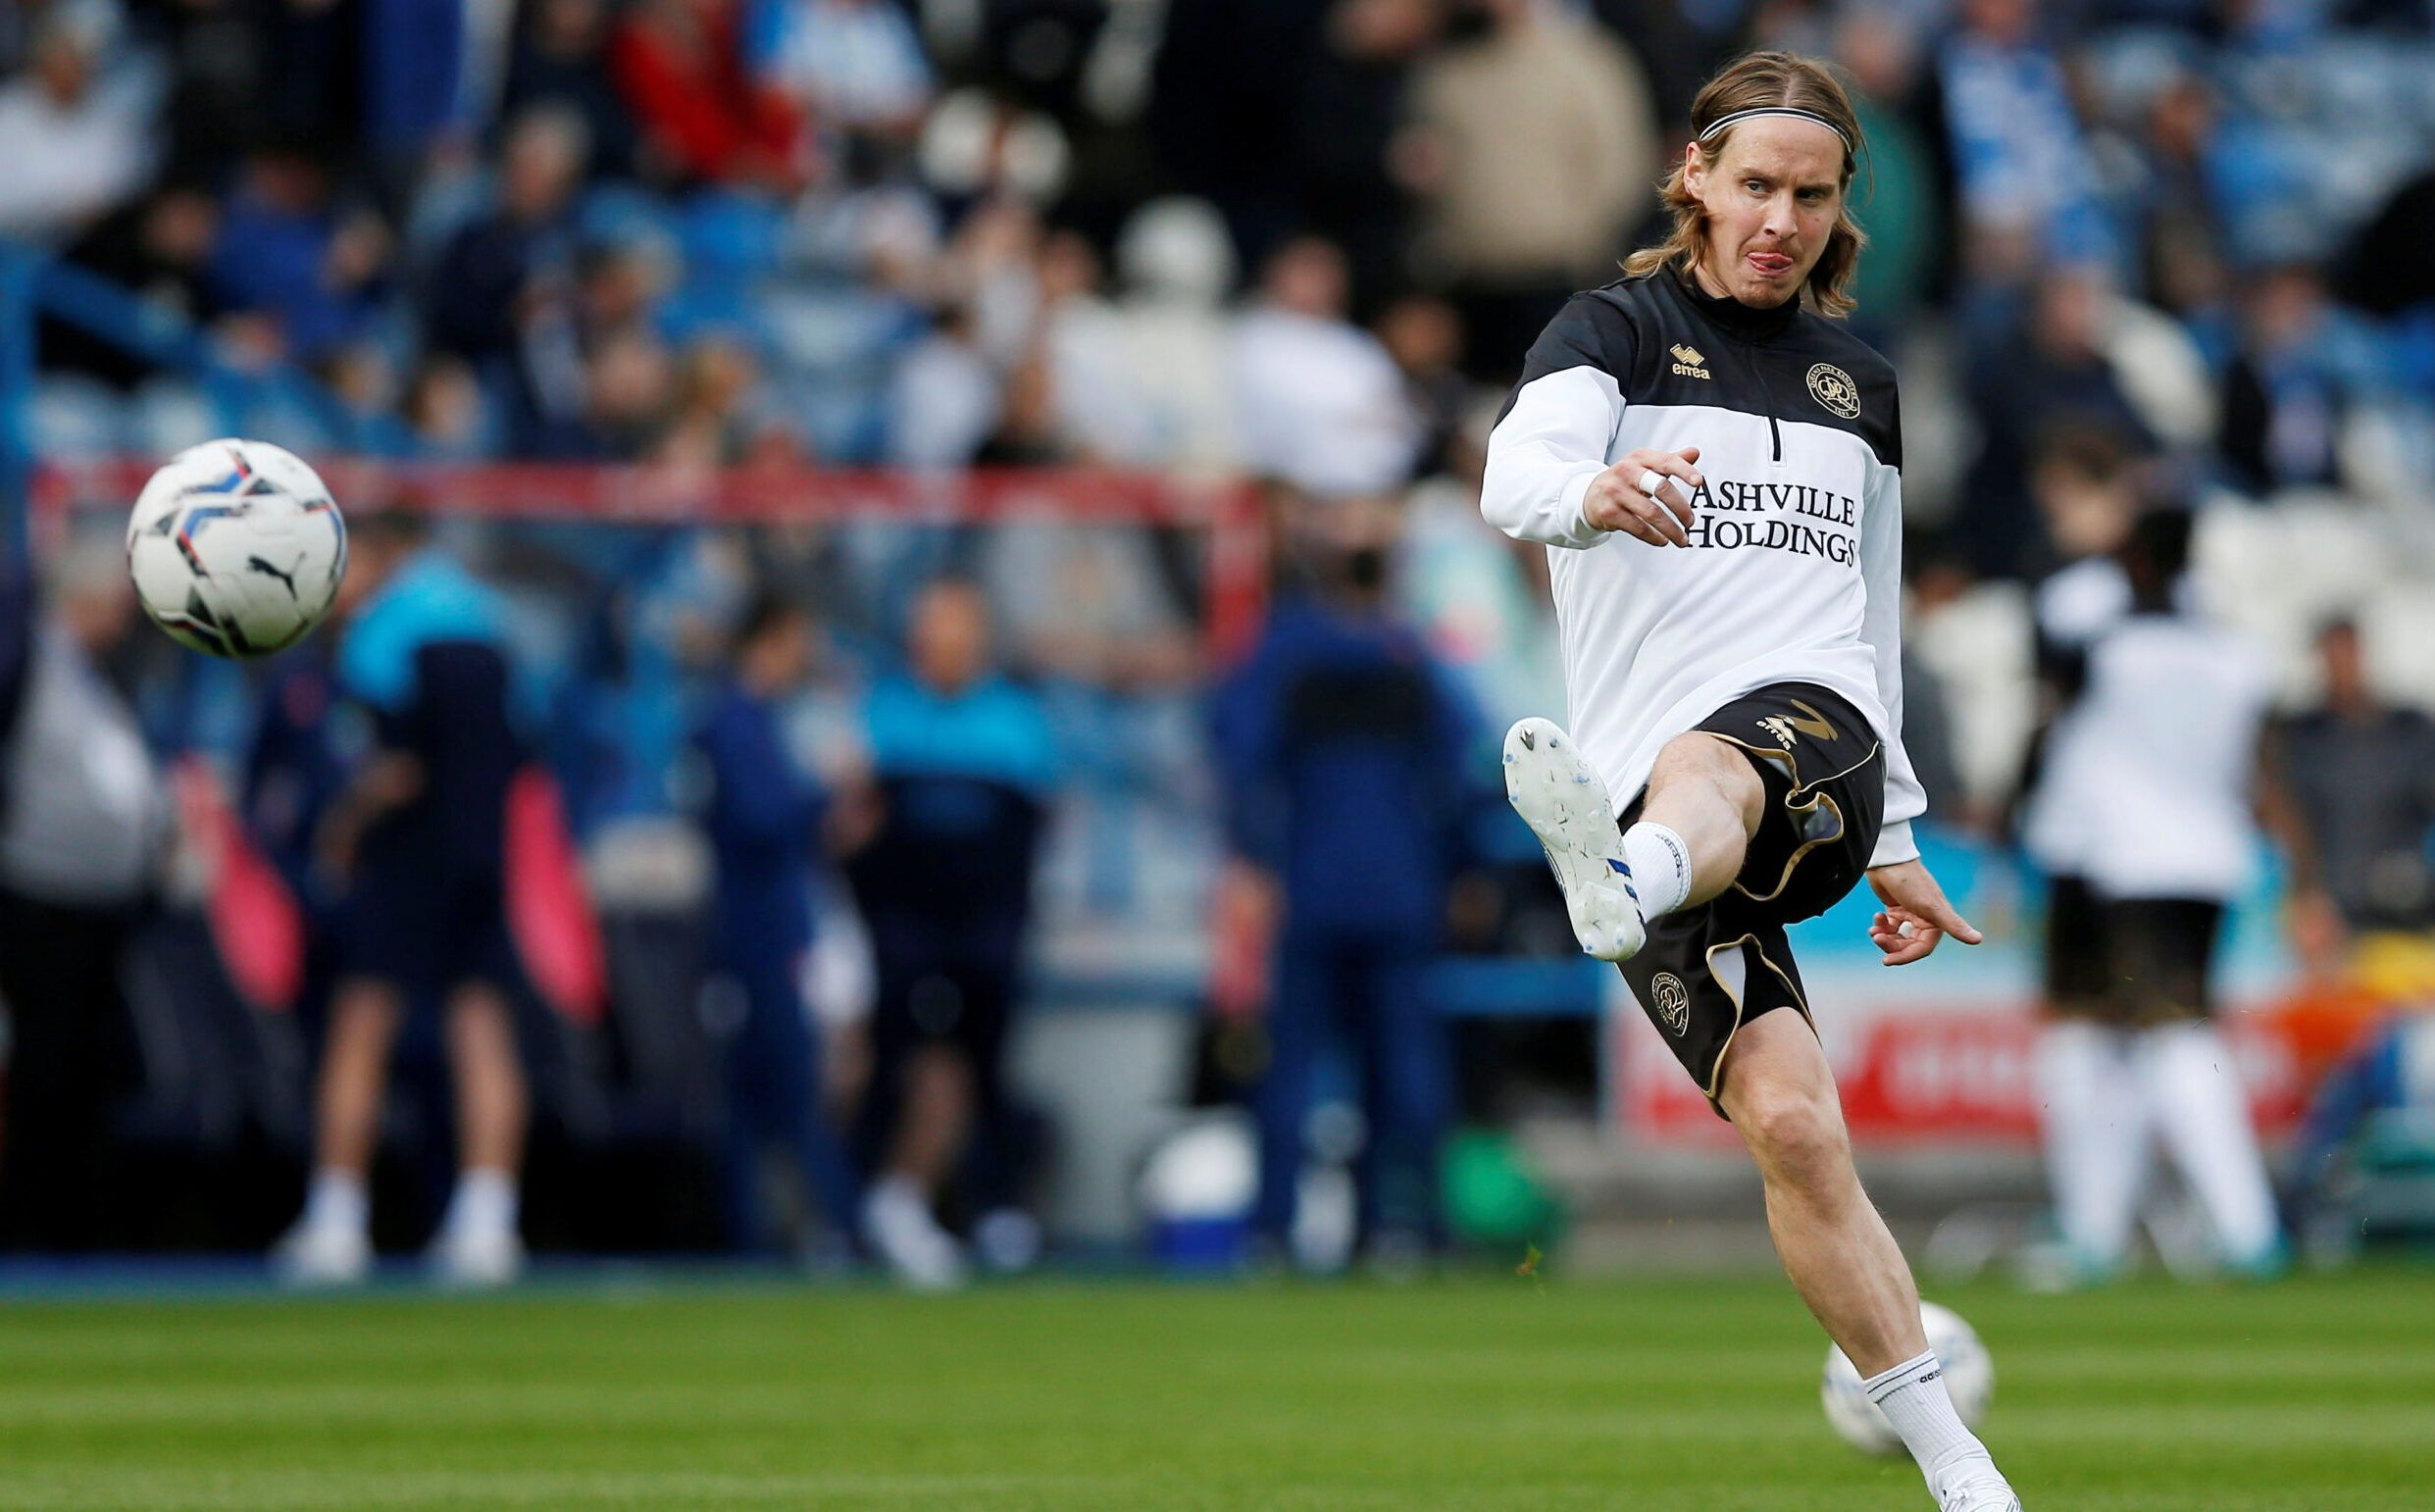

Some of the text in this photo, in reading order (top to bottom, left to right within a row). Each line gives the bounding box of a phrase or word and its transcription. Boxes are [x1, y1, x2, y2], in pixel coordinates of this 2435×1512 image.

[1672, 363, 1710, 379] errea
[1691, 476, 1855, 528] ASHVILLE
[1684, 515, 1856, 568] HOLDINGS
[1755, 721, 1791, 750] errea
